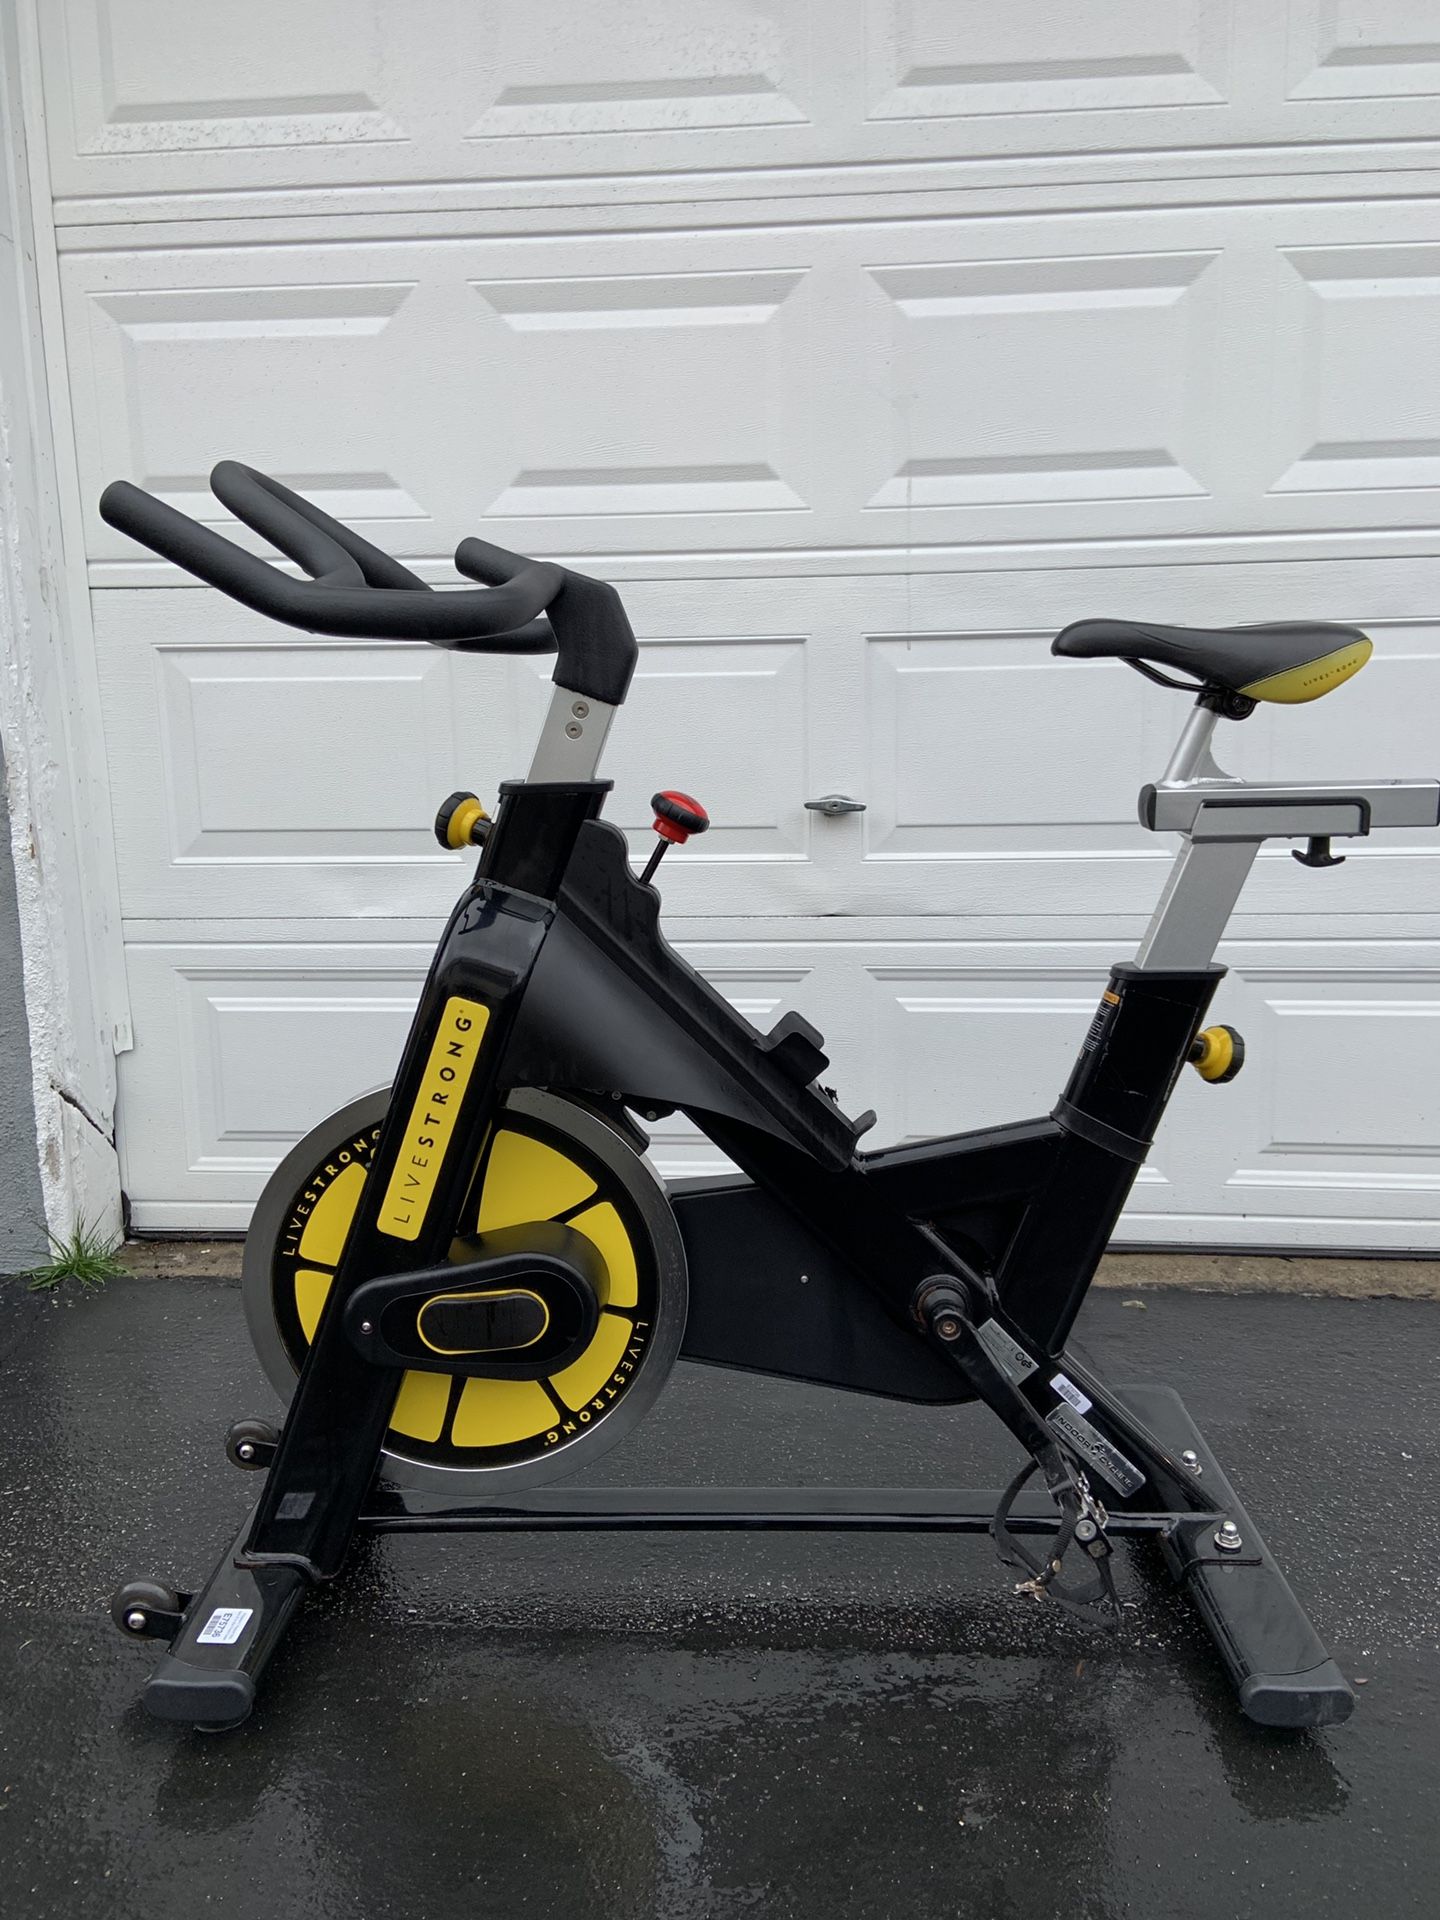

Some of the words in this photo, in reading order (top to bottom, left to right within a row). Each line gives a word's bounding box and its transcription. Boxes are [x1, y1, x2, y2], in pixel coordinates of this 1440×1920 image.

[393, 1017, 473, 1224] LIVESTRONG
[283, 1129, 381, 1256] LIVESTRONG
[546, 1321, 649, 1444] LIVESTRONG
[1056, 1415, 1091, 1449] INDOOR
